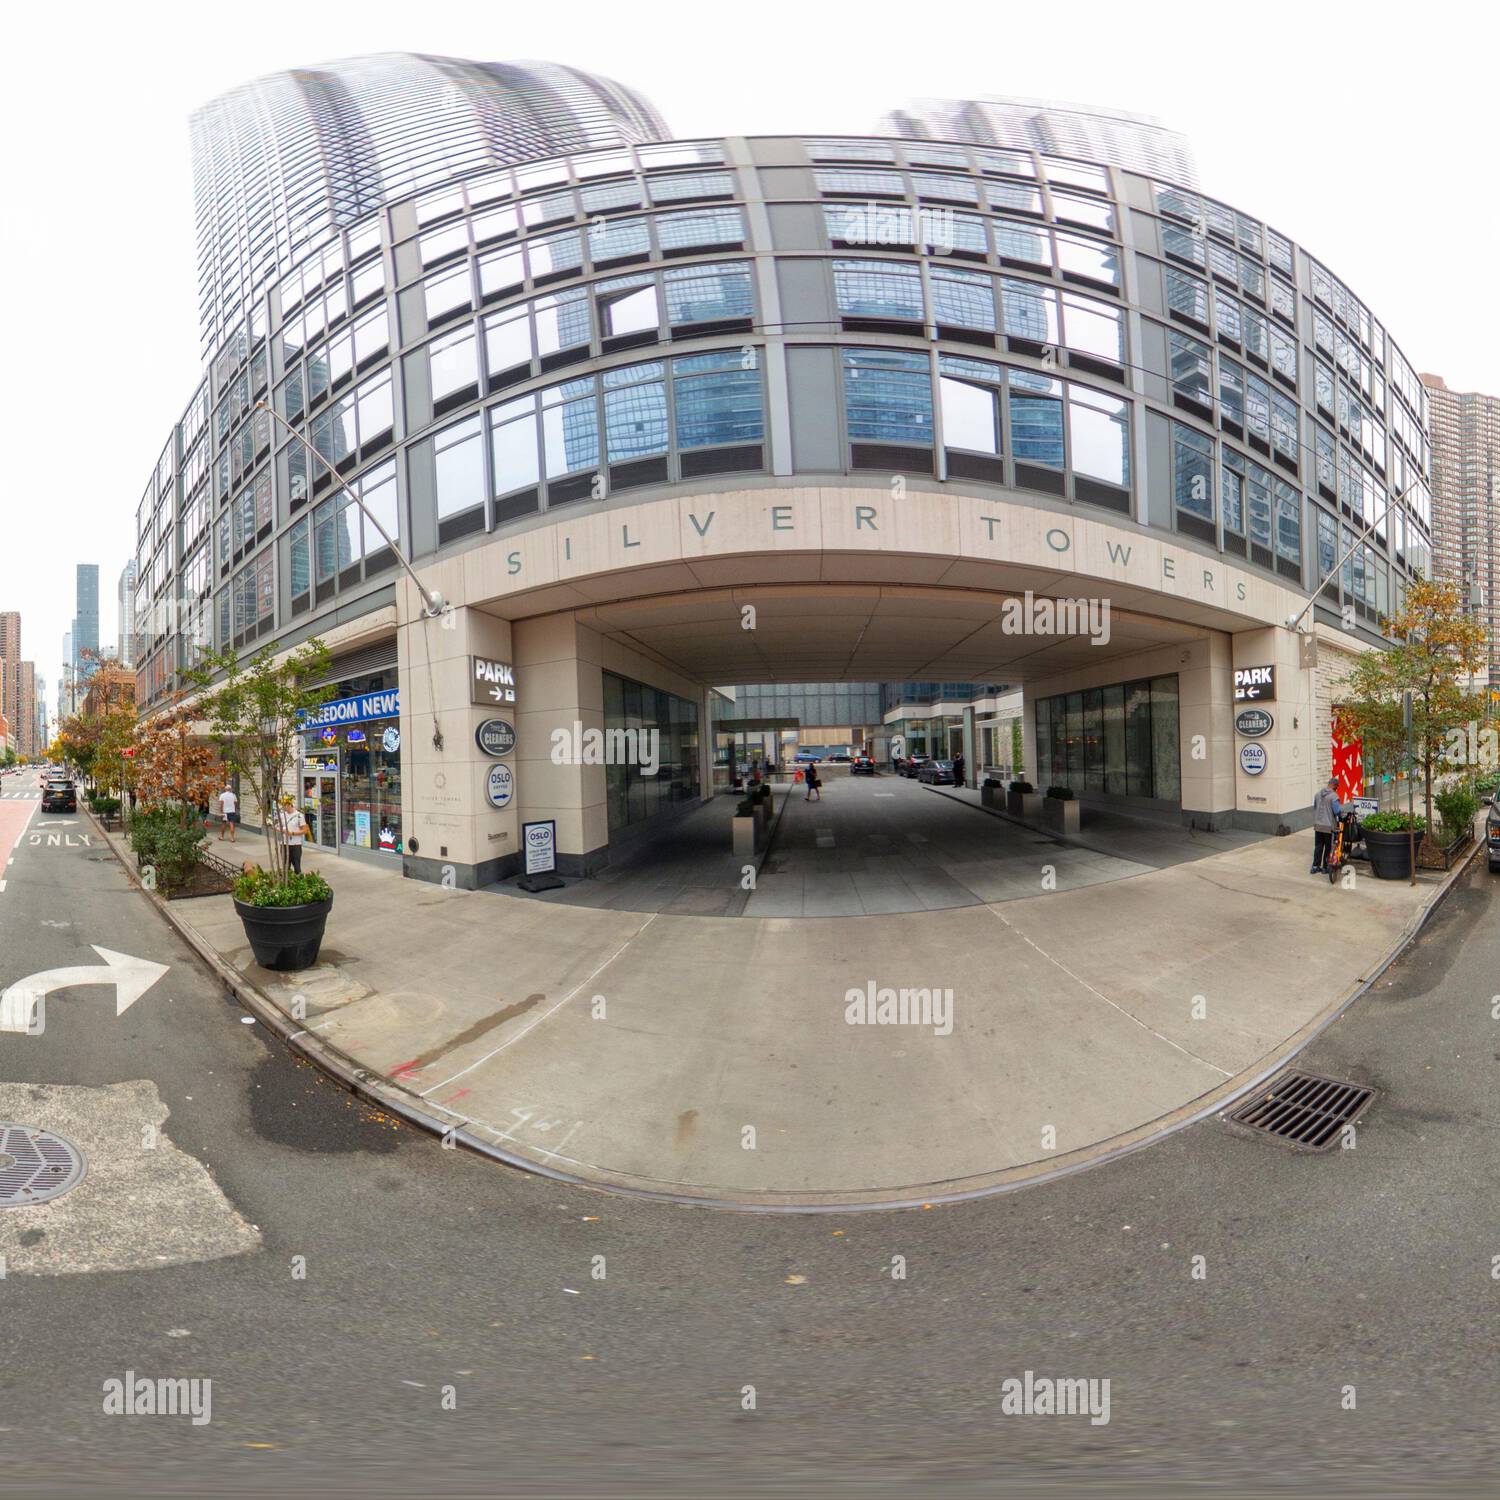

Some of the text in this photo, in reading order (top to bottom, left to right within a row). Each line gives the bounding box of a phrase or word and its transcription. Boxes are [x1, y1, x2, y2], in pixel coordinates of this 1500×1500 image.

[507, 505, 1247, 601] SILVER TOWERS
[476, 660, 514, 685] PARK
[1234, 667, 1272, 686] PARK
[1238, 719, 1268, 729] CLEANERS
[484, 733, 514, 745] CLEANERS
[1243, 749, 1262, 757] OSLO
[491, 773, 510, 784] OSLO
[29, 834, 92, 847] ONLY
[530, 831, 549, 841] OSLO
